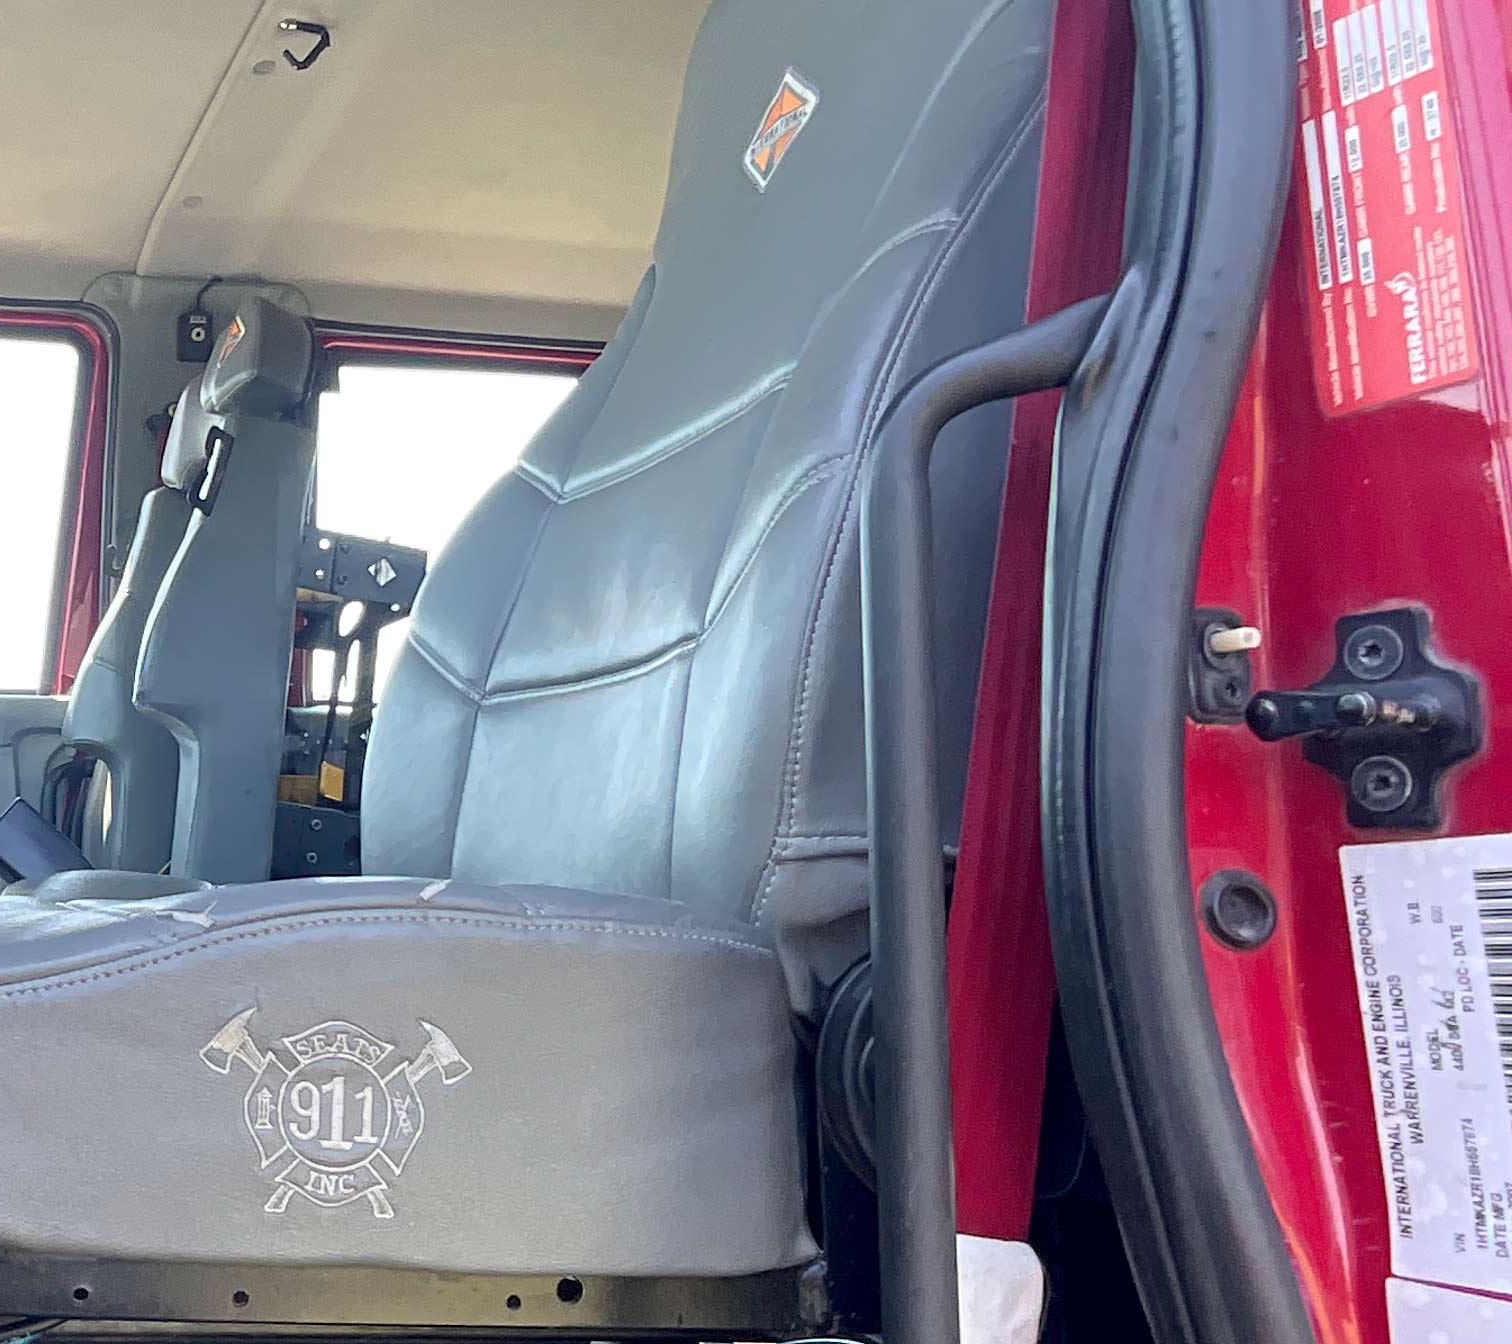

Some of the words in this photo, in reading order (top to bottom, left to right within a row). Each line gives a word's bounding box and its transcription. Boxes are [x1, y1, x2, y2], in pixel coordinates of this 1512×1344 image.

[1314, 208, 1329, 285] INTERNATIONAL
[1401, 287, 1427, 384] FERRARA
[1351, 875, 1378, 977] CORPORATION
[1449, 925, 1467, 957] DATE
[1456, 967, 1473, 993] LOC
[1365, 981, 1386, 1032] ENGINE
[1387, 975, 1409, 1032] ILLINOIS
[296, 1033, 380, 1064] SEATS
[1374, 1035, 1391, 1066] AND
[1426, 1028, 1443, 1071] MODEL
[289, 1076, 378, 1150] 911
[1378, 1070, 1395, 1118] TRUCK
[306, 1170, 355, 1196] INC
[1388, 1123, 1413, 1239] INTERNATIONAL
[1490, 1193, 1505, 1220] MFG
[1454, 1233, 1466, 1254] VIN
[1493, 1225, 1509, 1258] DATE
